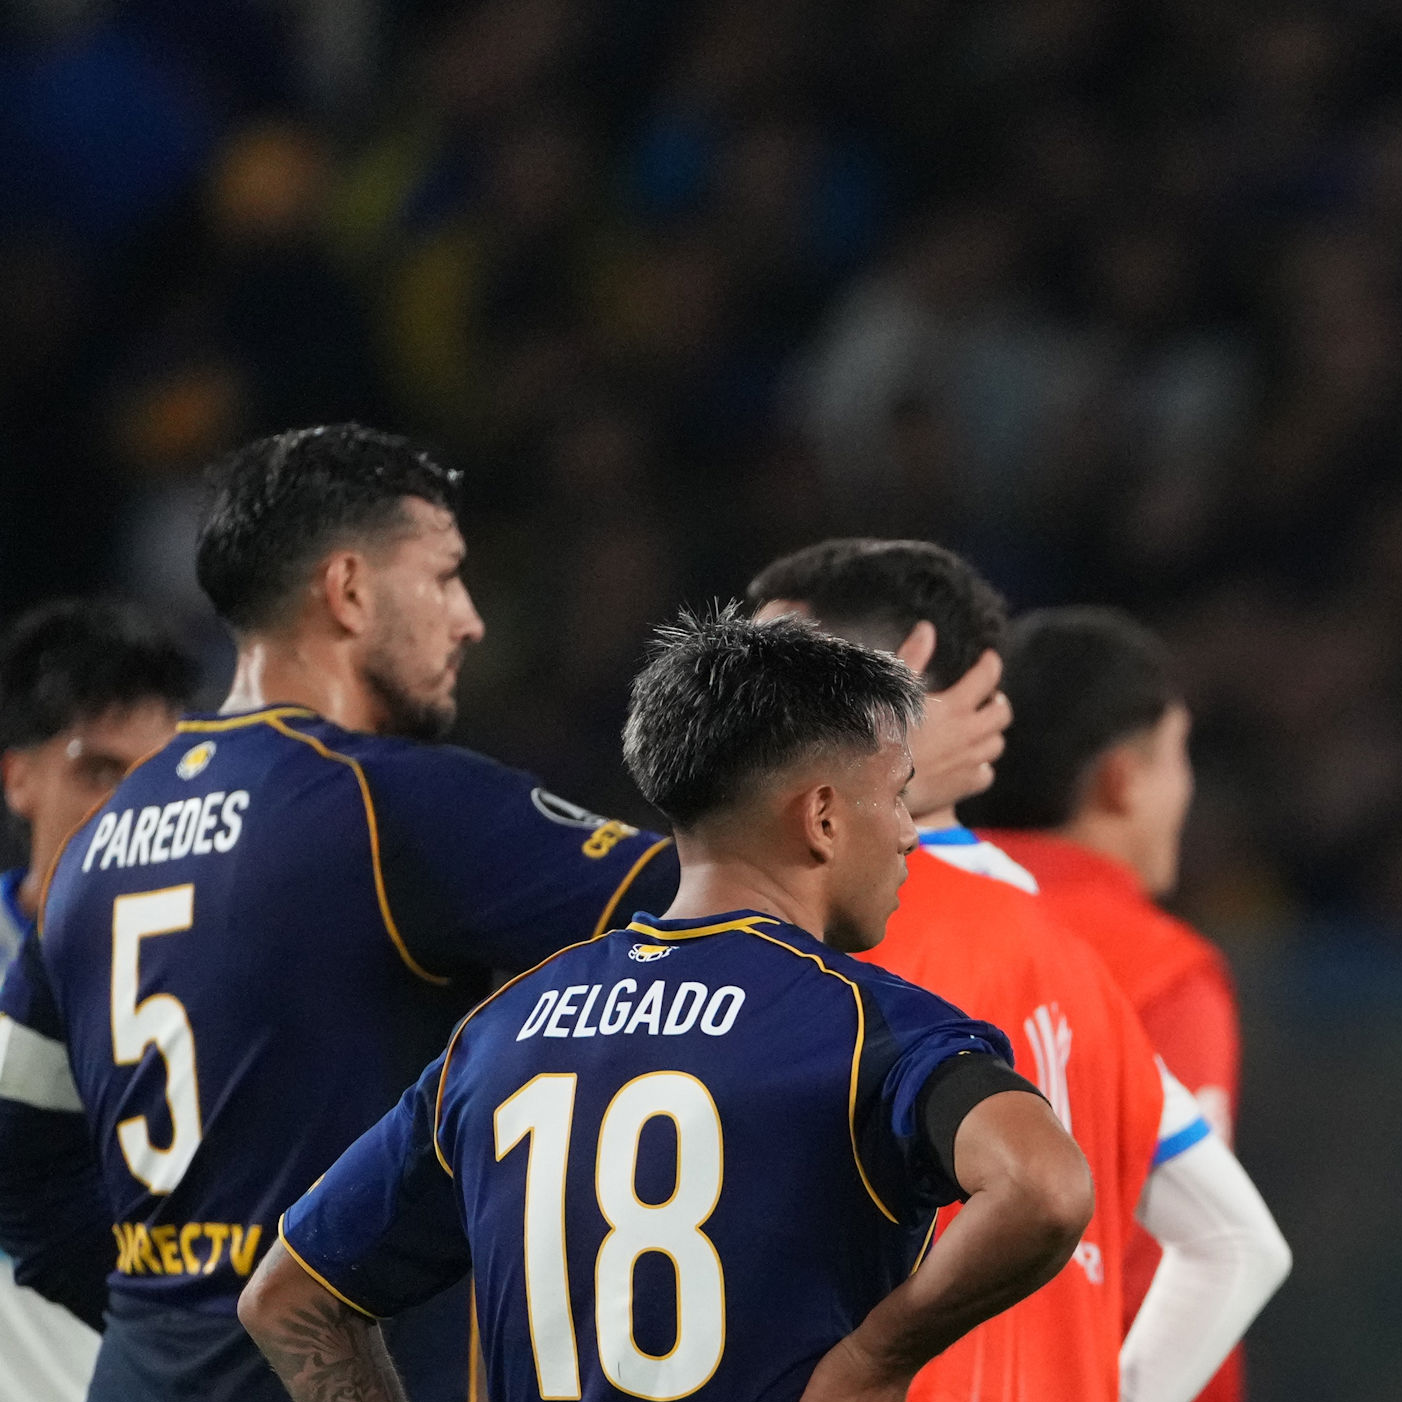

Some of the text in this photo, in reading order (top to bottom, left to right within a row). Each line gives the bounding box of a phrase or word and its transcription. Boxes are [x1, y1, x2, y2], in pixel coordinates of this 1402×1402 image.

[82, 790, 250, 873] PAREDES
[111, 885, 202, 1194] 5
[515, 978, 746, 1042] DELGADO
[493, 1071, 726, 1401] 18
